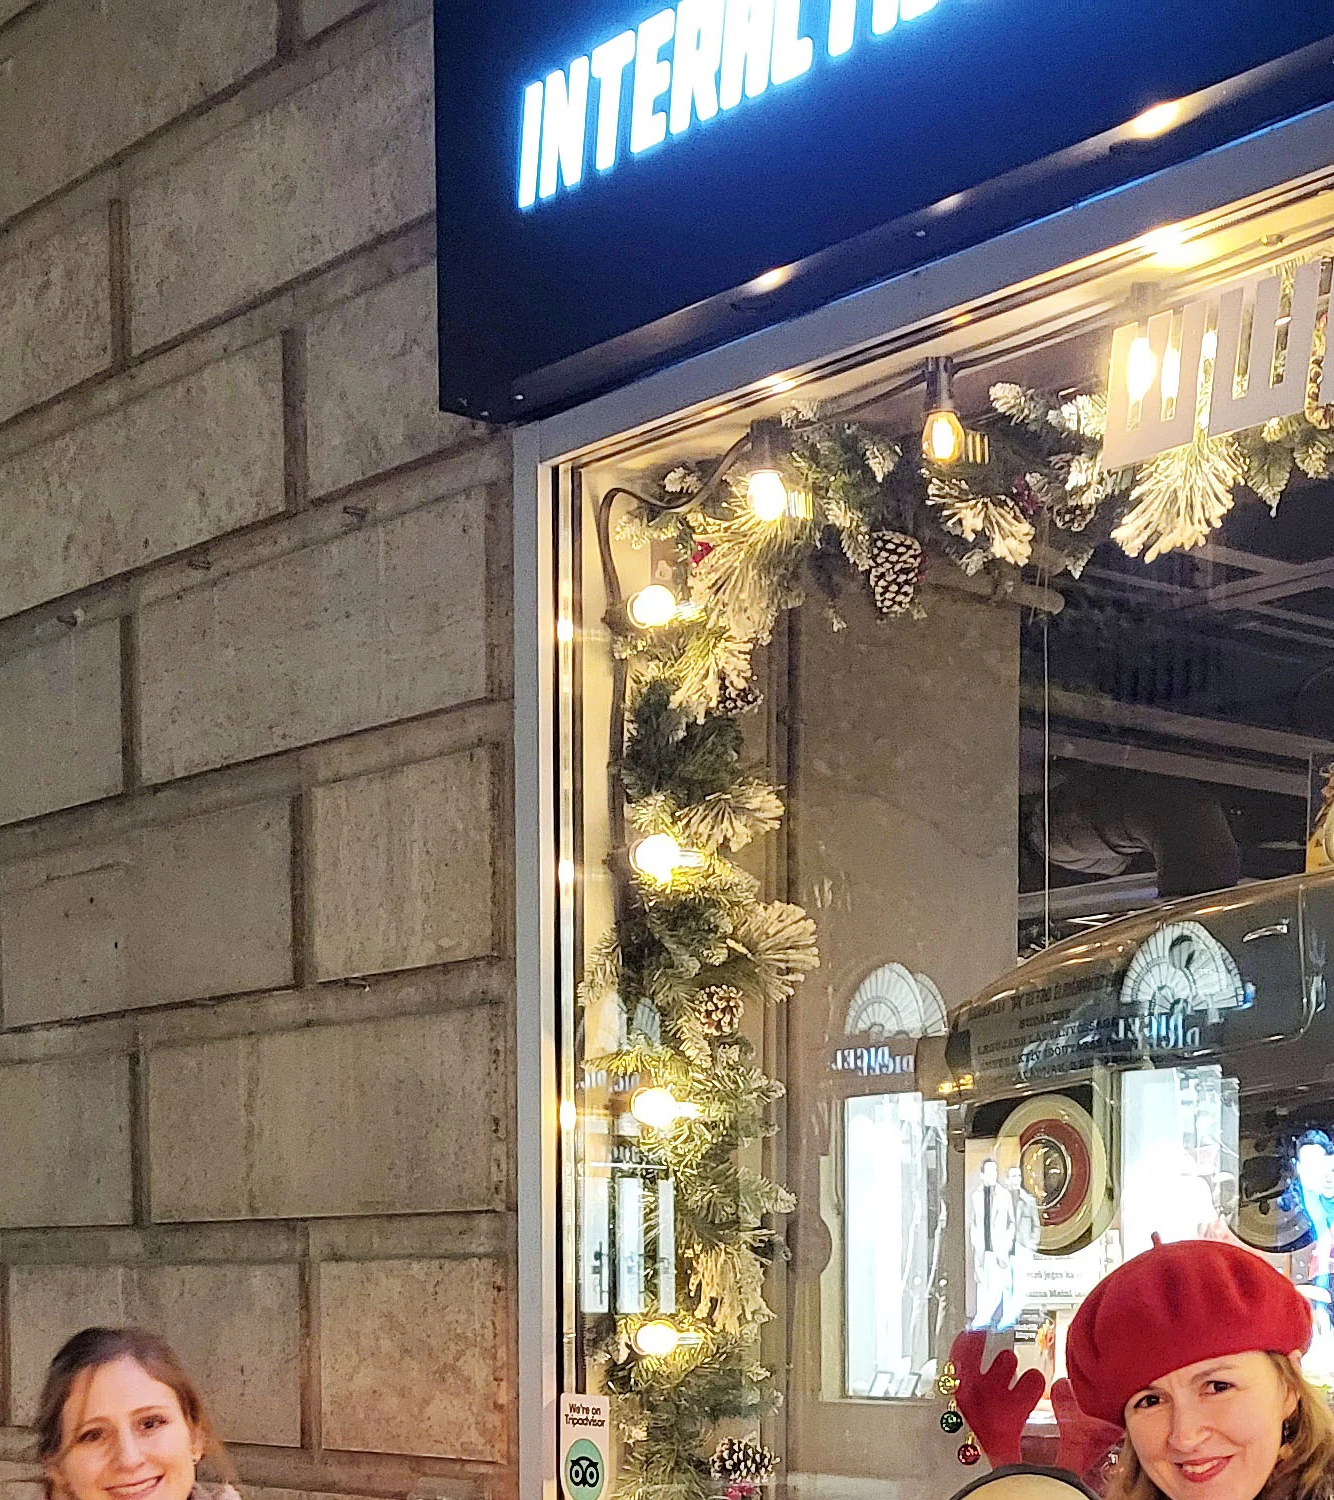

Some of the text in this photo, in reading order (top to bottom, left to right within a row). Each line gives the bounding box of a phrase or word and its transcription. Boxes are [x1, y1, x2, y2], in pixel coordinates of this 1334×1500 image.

[568, 1403, 601, 1415] We're on
[564, 1414, 606, 1428] Tripadvisor
